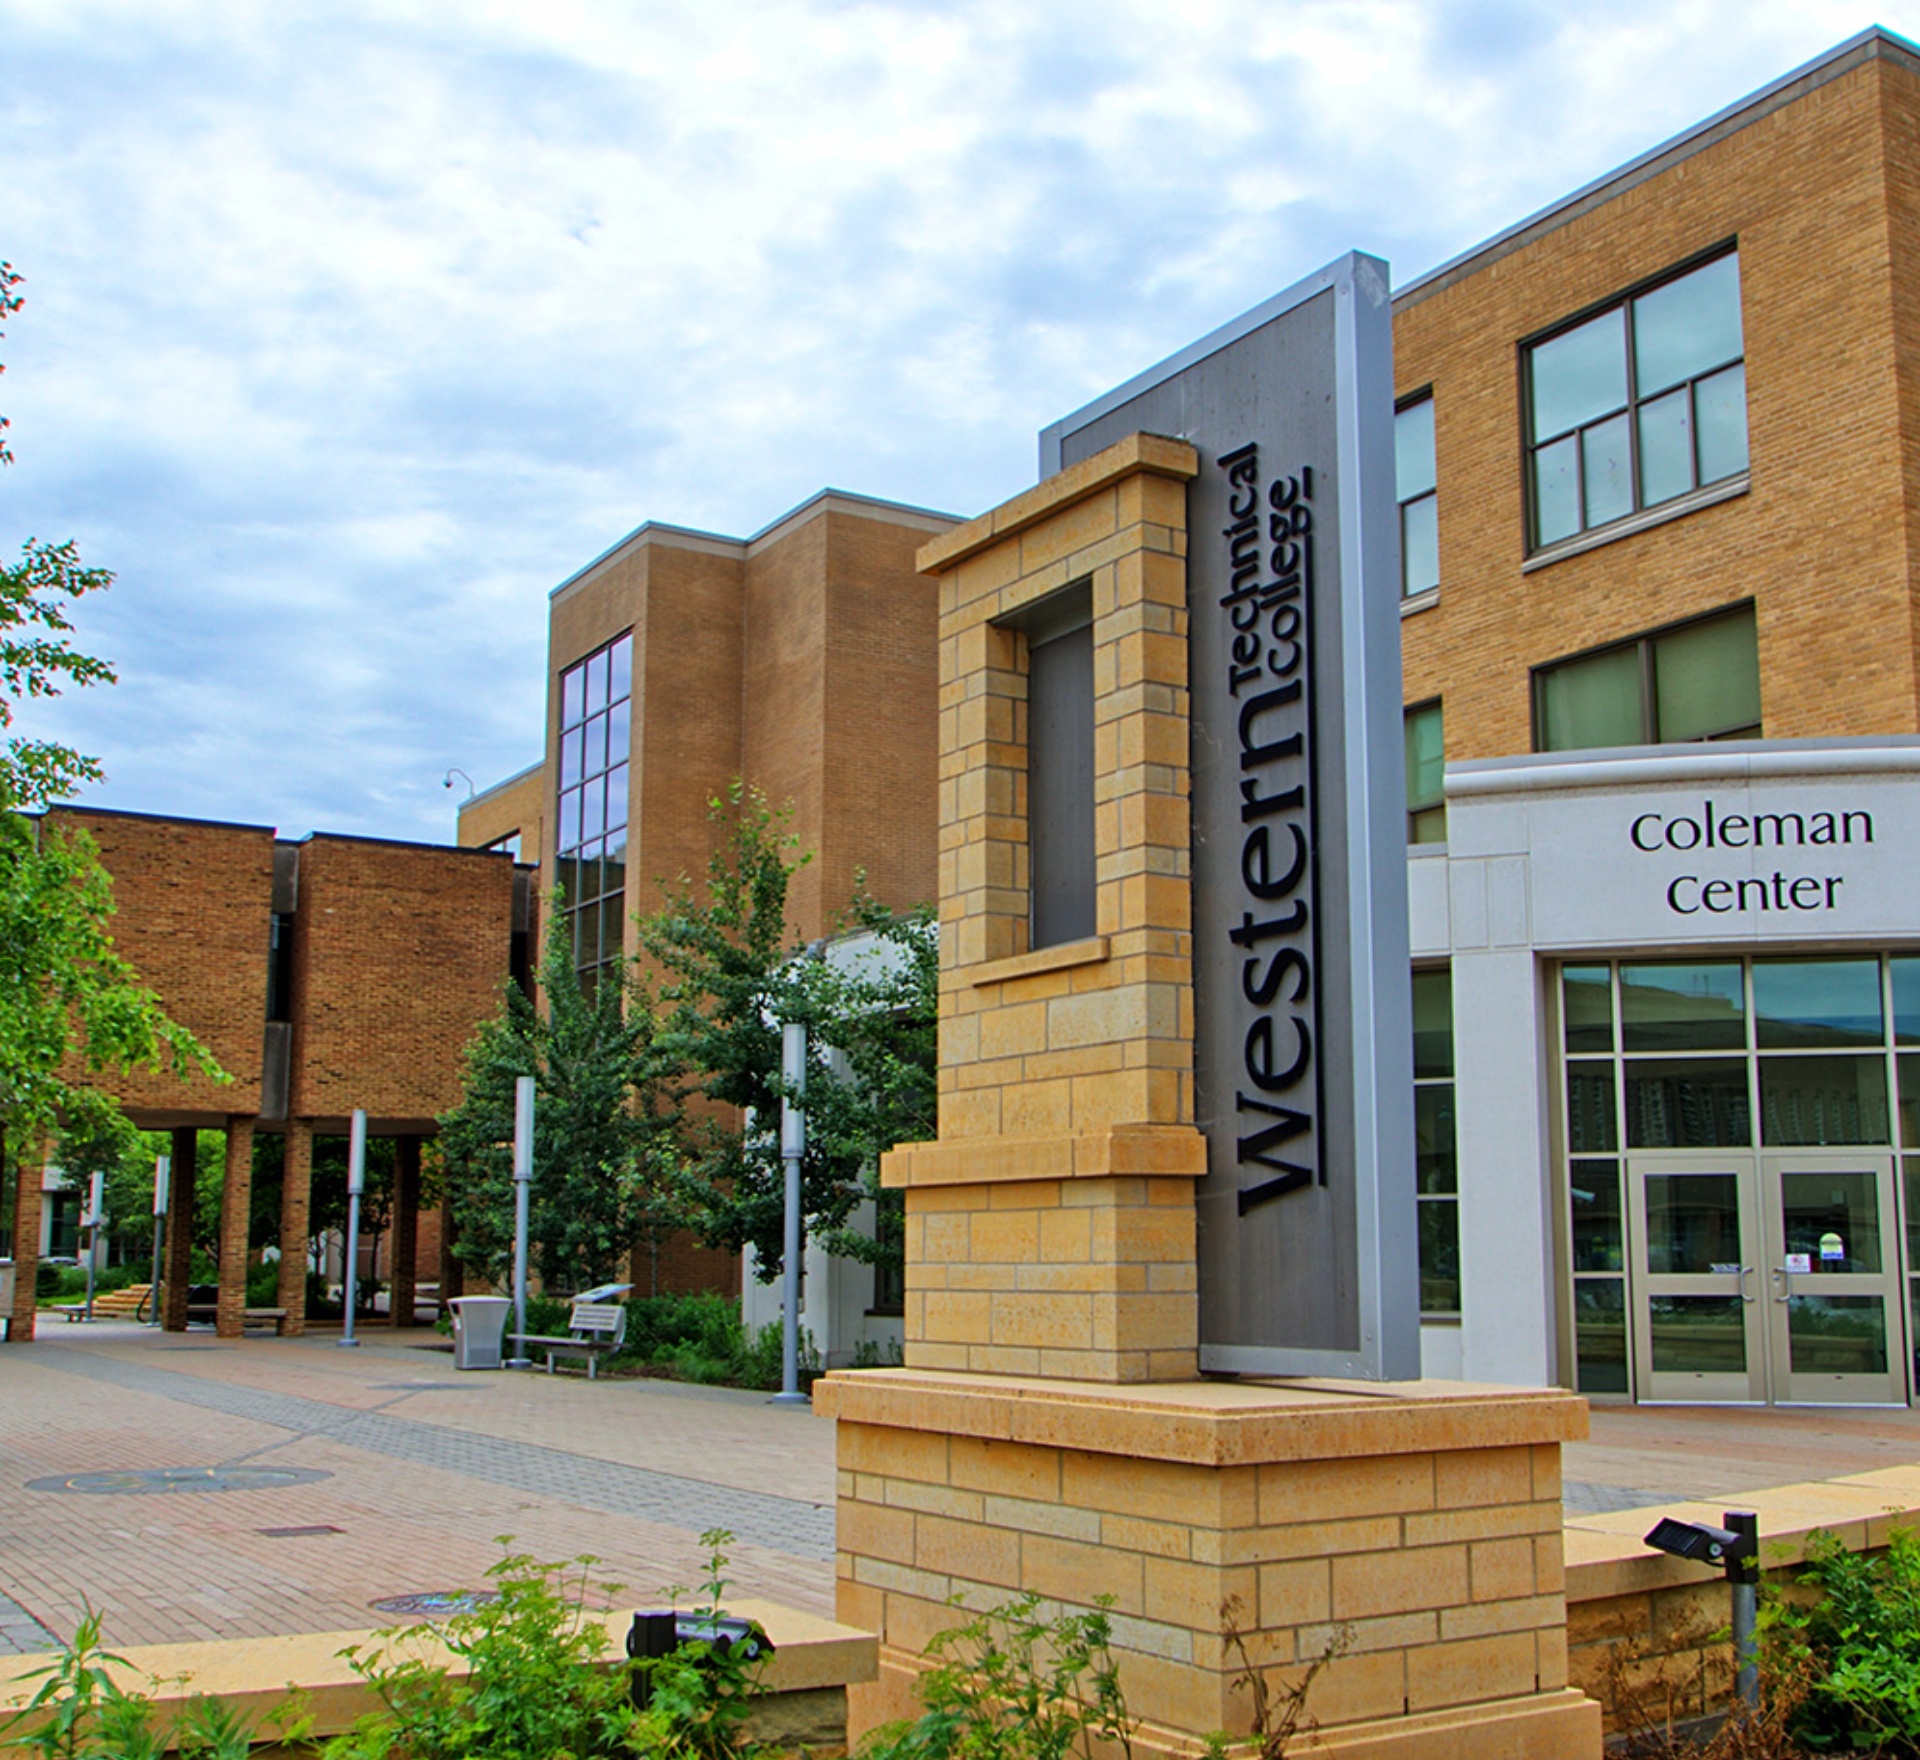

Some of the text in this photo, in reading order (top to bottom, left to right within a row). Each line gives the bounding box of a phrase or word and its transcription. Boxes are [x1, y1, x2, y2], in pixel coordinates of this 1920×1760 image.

[1217, 441, 1262, 698] Technical
[1260, 475, 1313, 678] College
[1630, 800, 1875, 852] Coleman
[1667, 871, 1845, 915] Center
[1228, 678, 1314, 1219] Western
